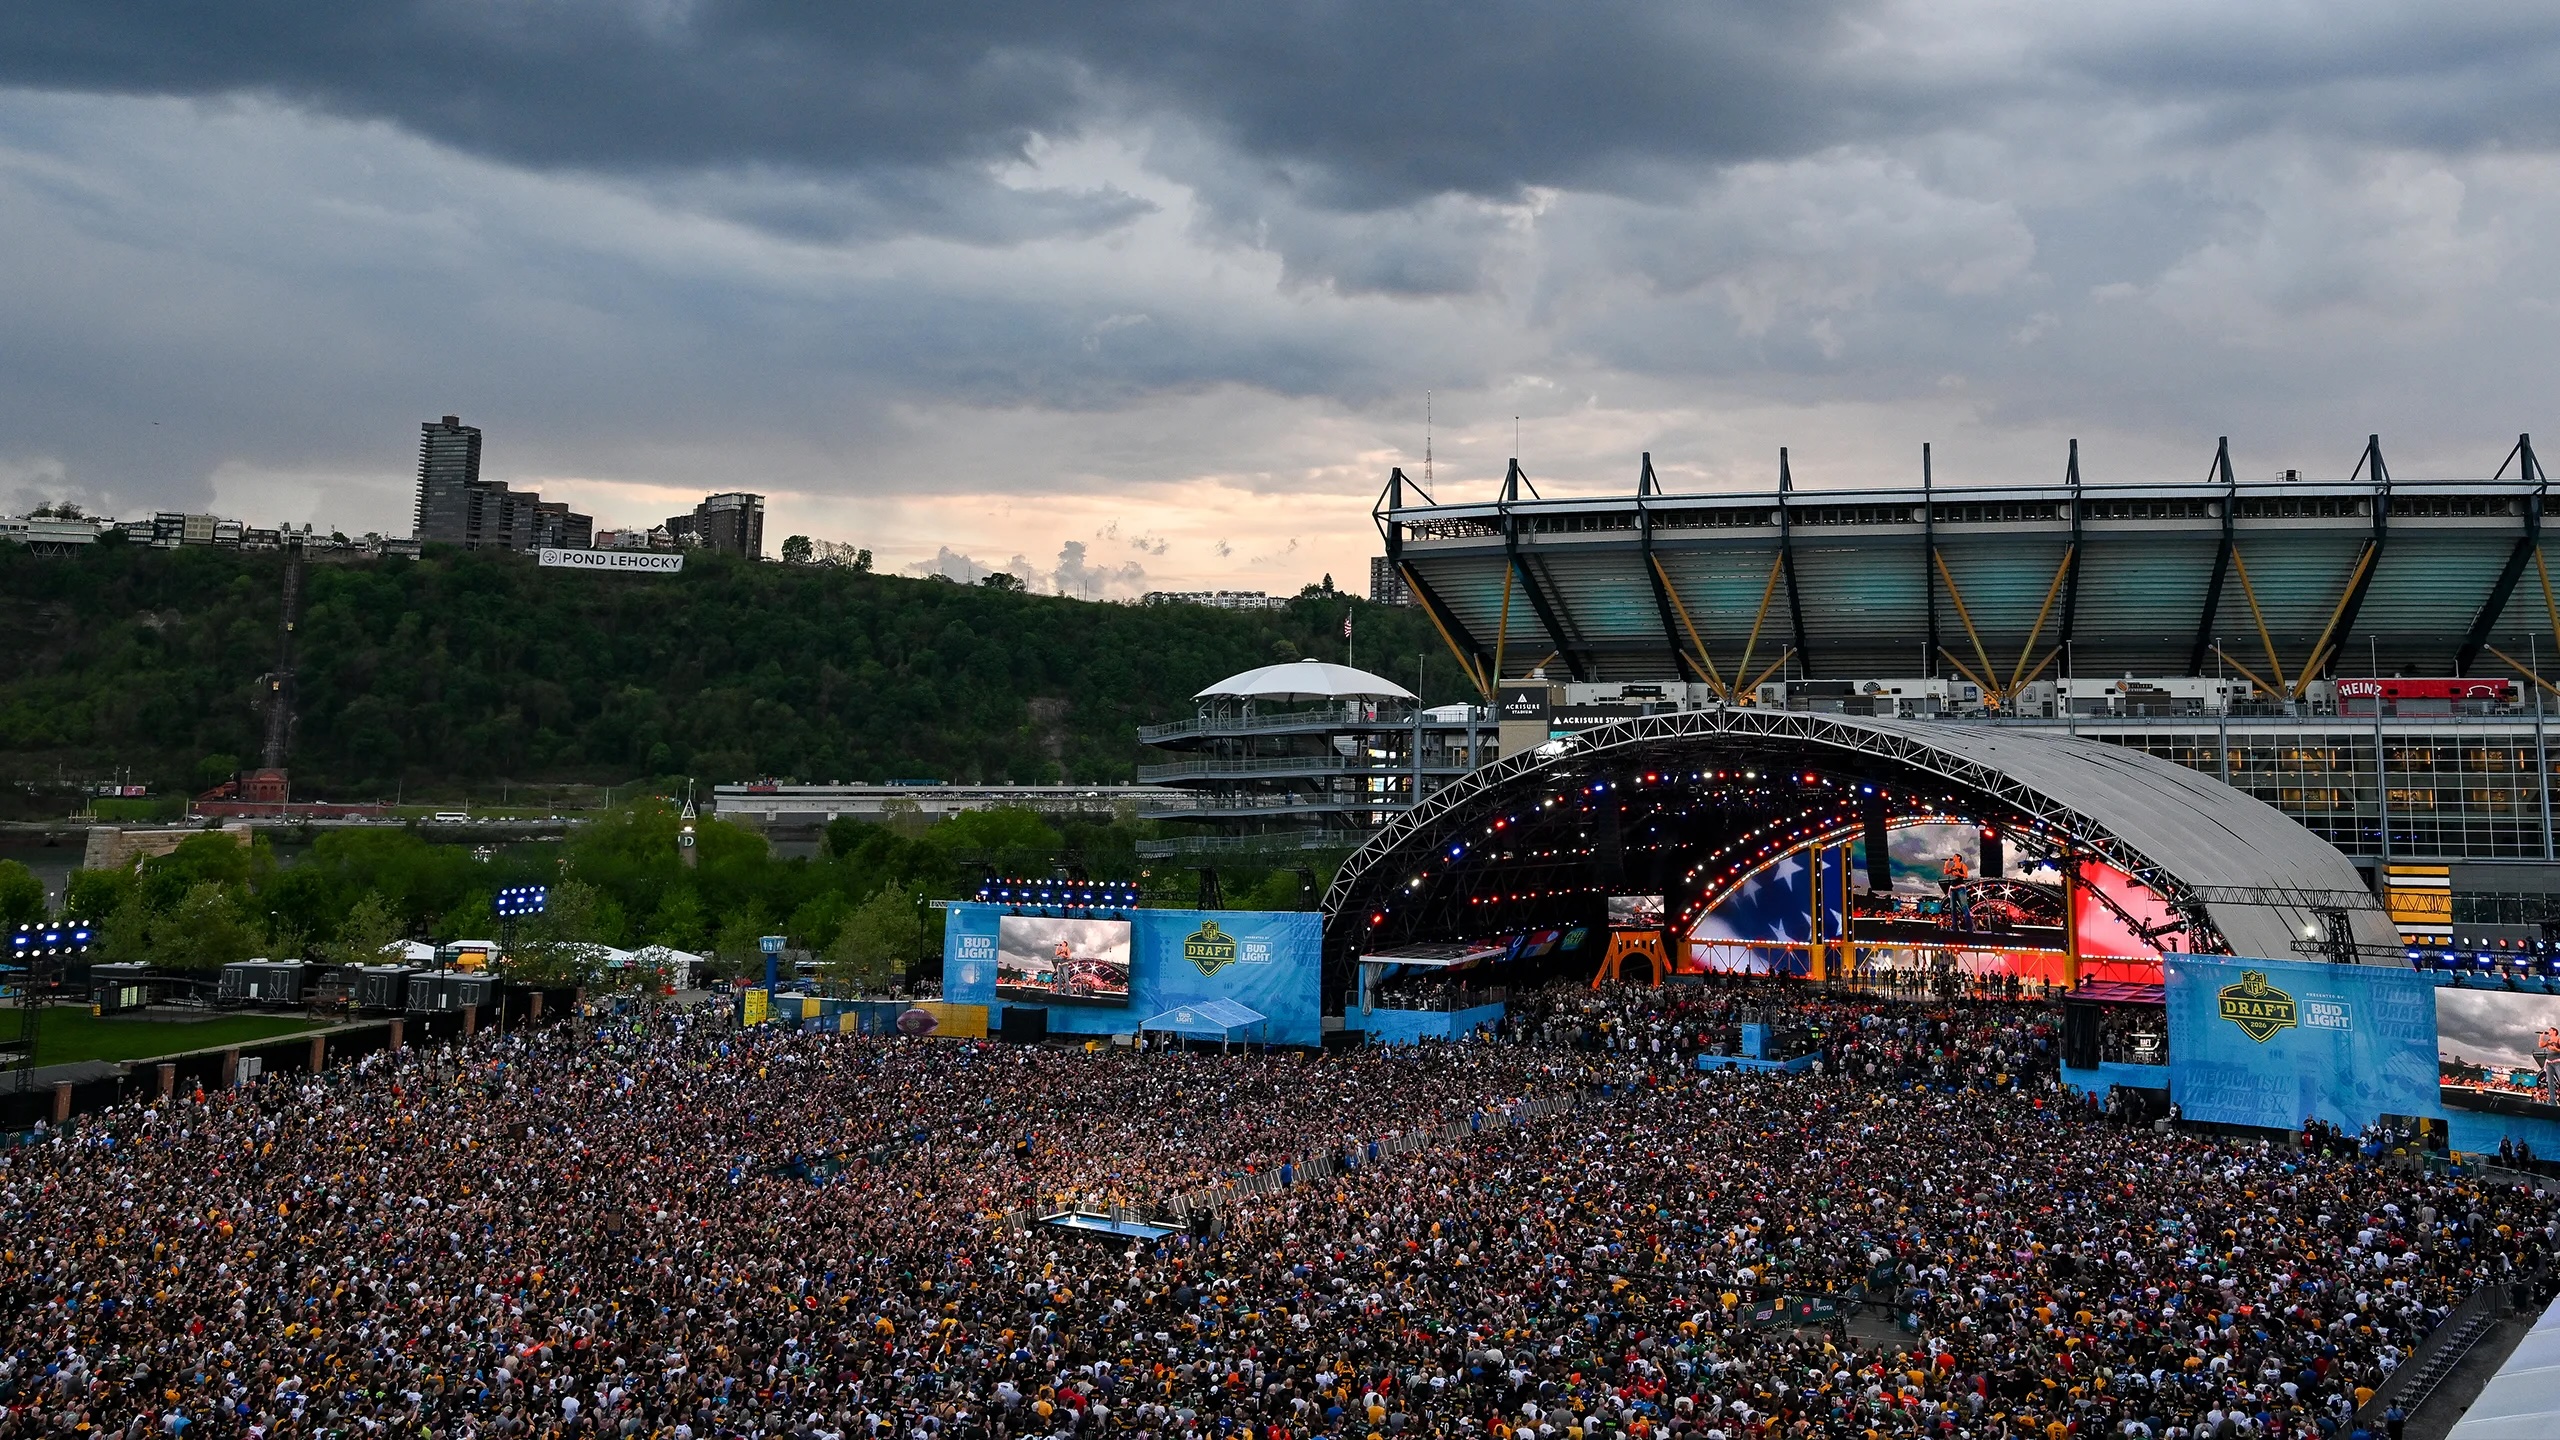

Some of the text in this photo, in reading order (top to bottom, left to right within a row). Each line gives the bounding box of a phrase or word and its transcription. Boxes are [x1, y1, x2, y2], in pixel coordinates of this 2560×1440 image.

[563, 553, 680, 568] POND LEHOCKY
[2341, 682, 2382, 696] HEINZ
[1202, 928, 1216, 939] NFL
[963, 937, 991, 948] BUD
[1246, 944, 1267, 953] BUD
[957, 947, 995, 959] LIGHT
[1188, 945, 1232, 957] DRAFT
[1241, 952, 1270, 962] LIGHT
[2245, 981, 2263, 993] NFL
[2225, 1000, 2289, 1018] DRAFT
[2310, 1003, 2343, 1016] BUD
[2250, 1021, 2267, 1029] 2026
[2305, 1013, 2349, 1028] LIGHT
